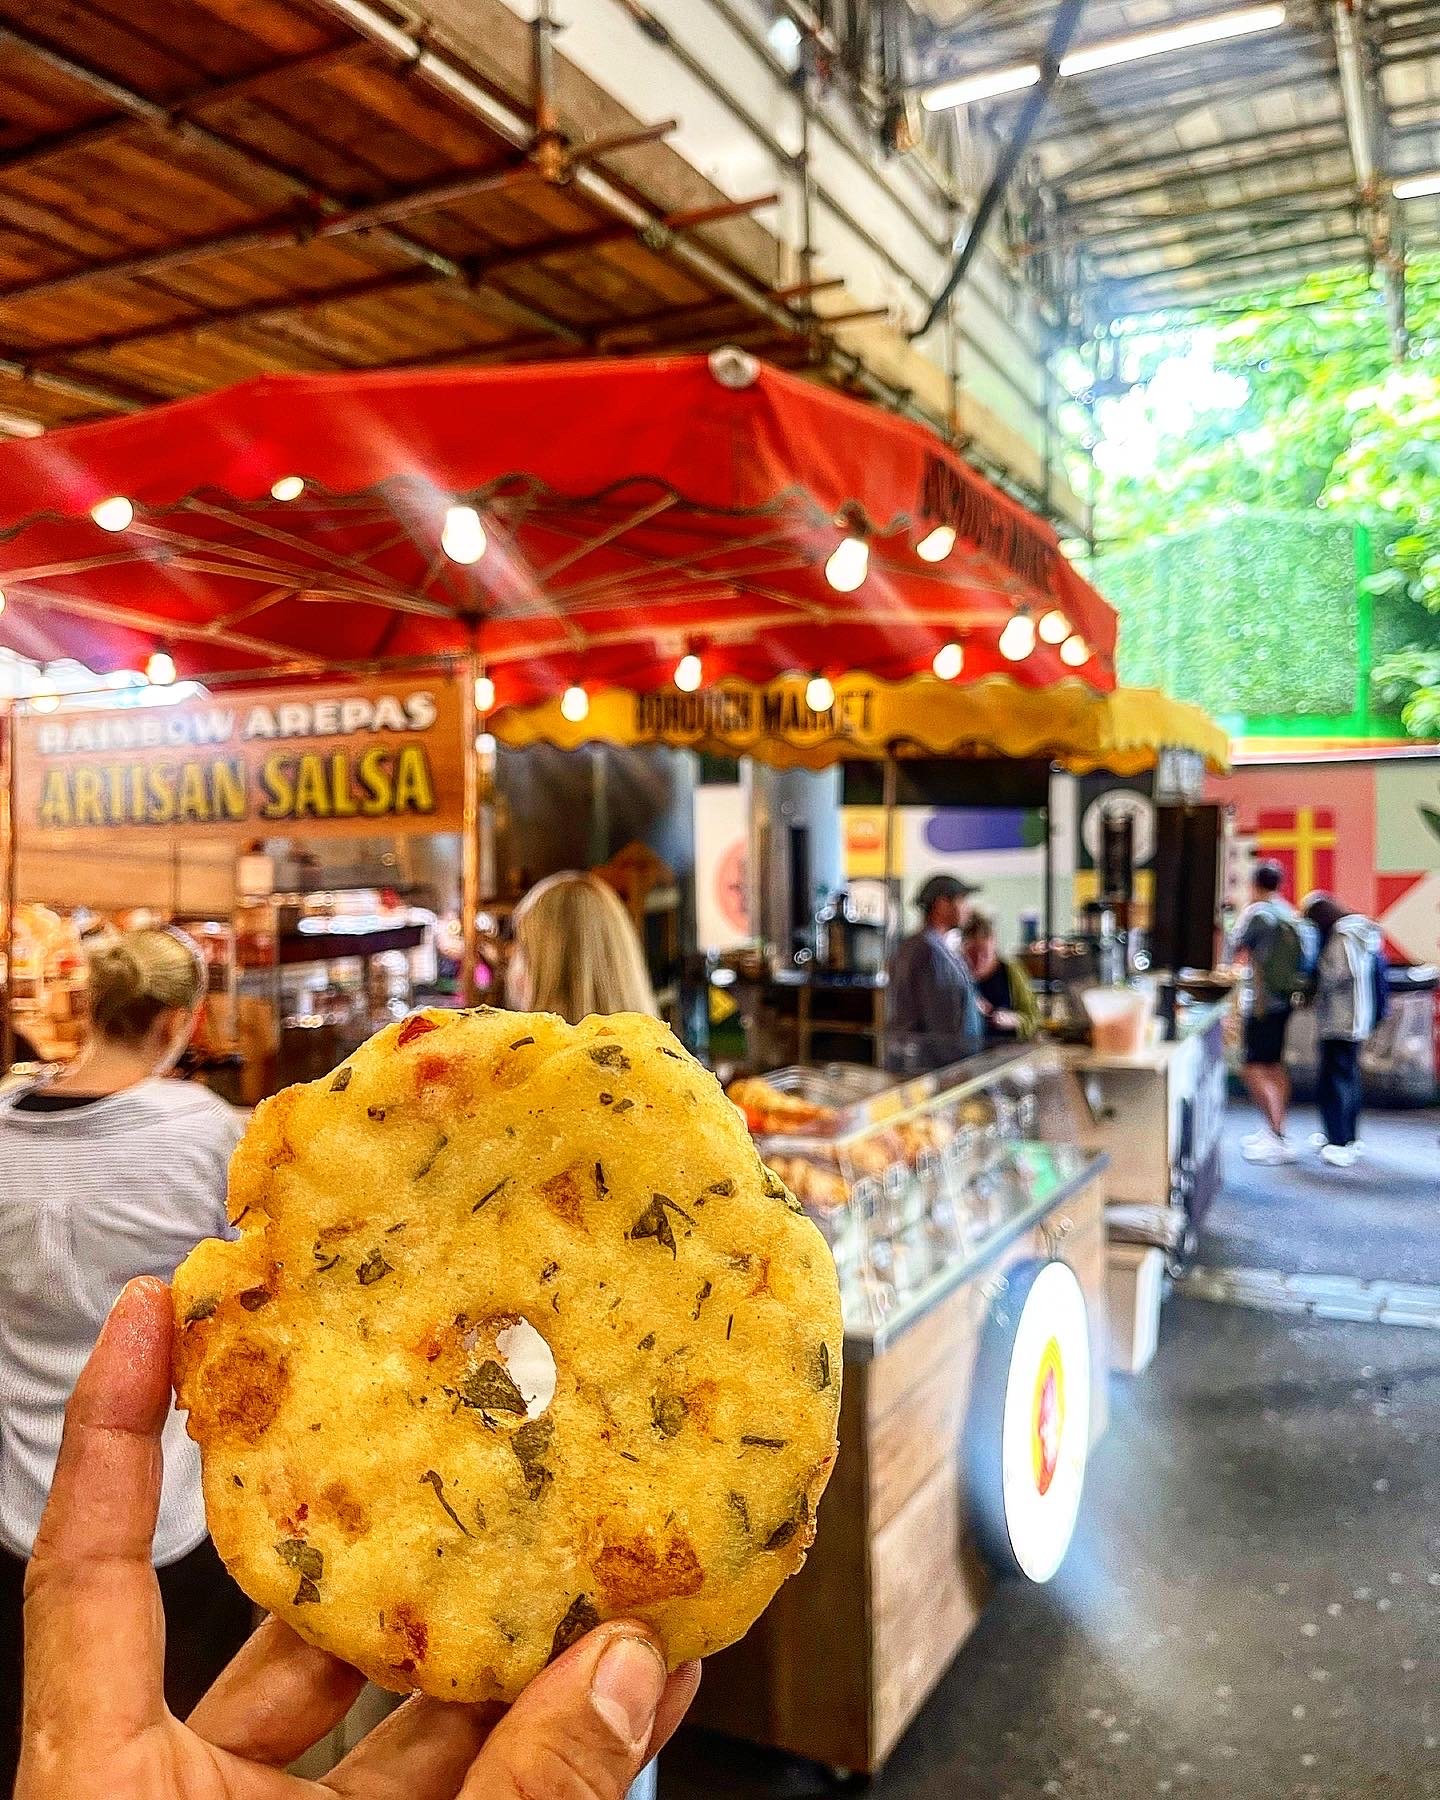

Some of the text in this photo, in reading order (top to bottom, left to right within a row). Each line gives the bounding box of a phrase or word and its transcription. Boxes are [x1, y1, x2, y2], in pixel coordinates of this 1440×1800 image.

[39, 692, 436, 753] RAINBOW AREPAS
[40, 746, 434, 826] ARTISAN SALSA
